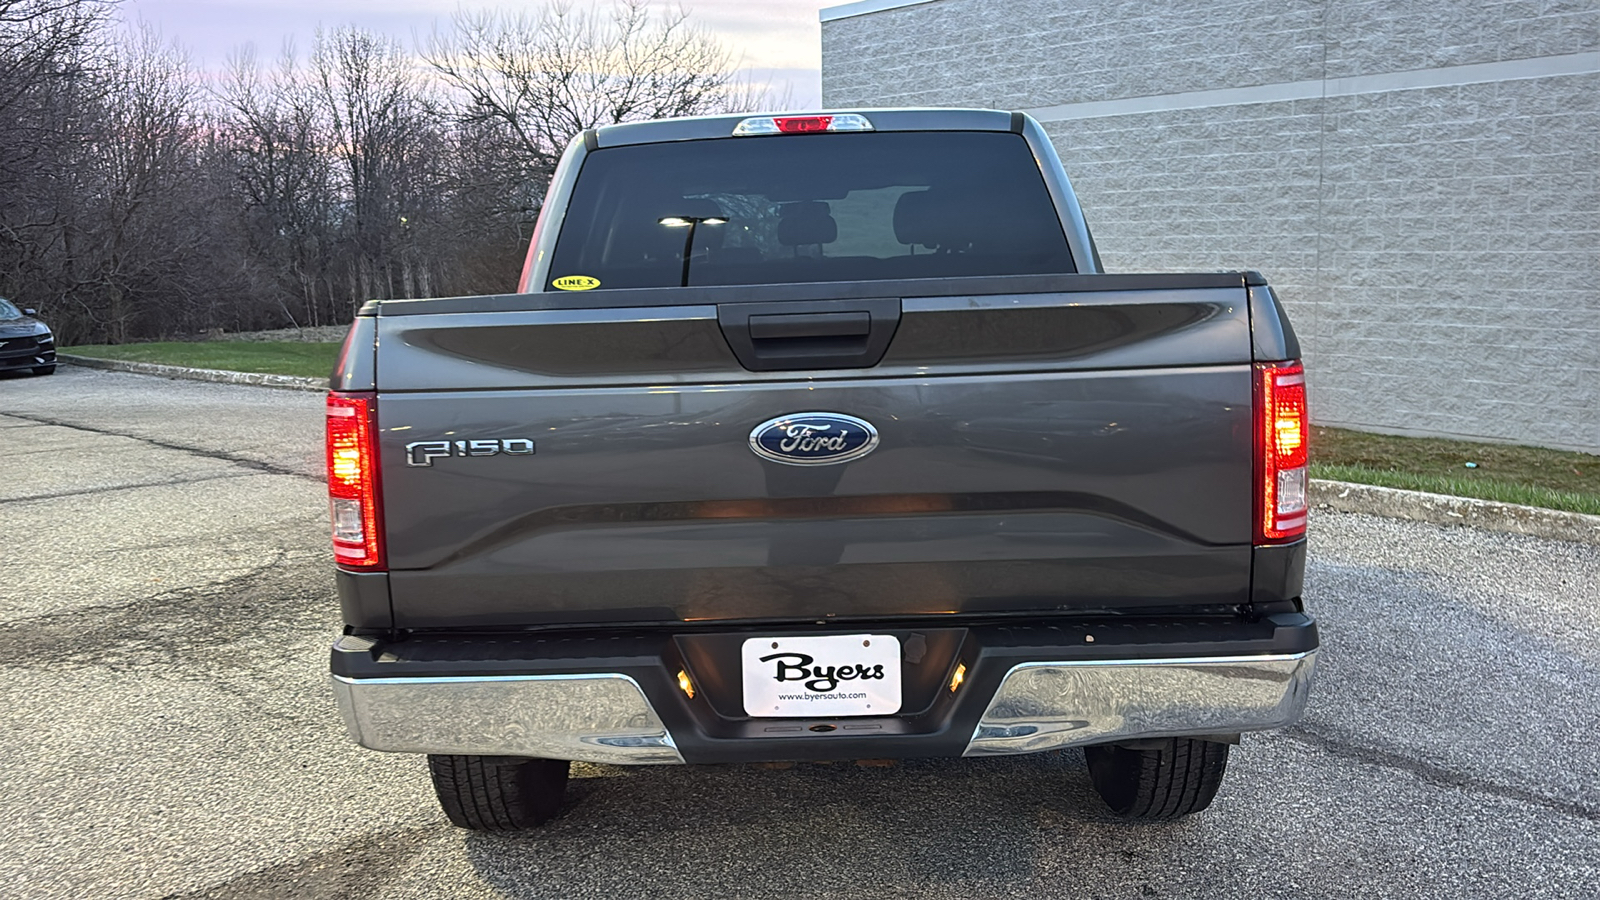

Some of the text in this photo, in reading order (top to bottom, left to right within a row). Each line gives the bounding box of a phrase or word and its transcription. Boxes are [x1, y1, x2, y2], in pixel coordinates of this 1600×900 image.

[780, 423, 848, 452] Ford
[759, 652, 884, 692] Byers
[778, 692, 867, 702] www.byersauto.com
